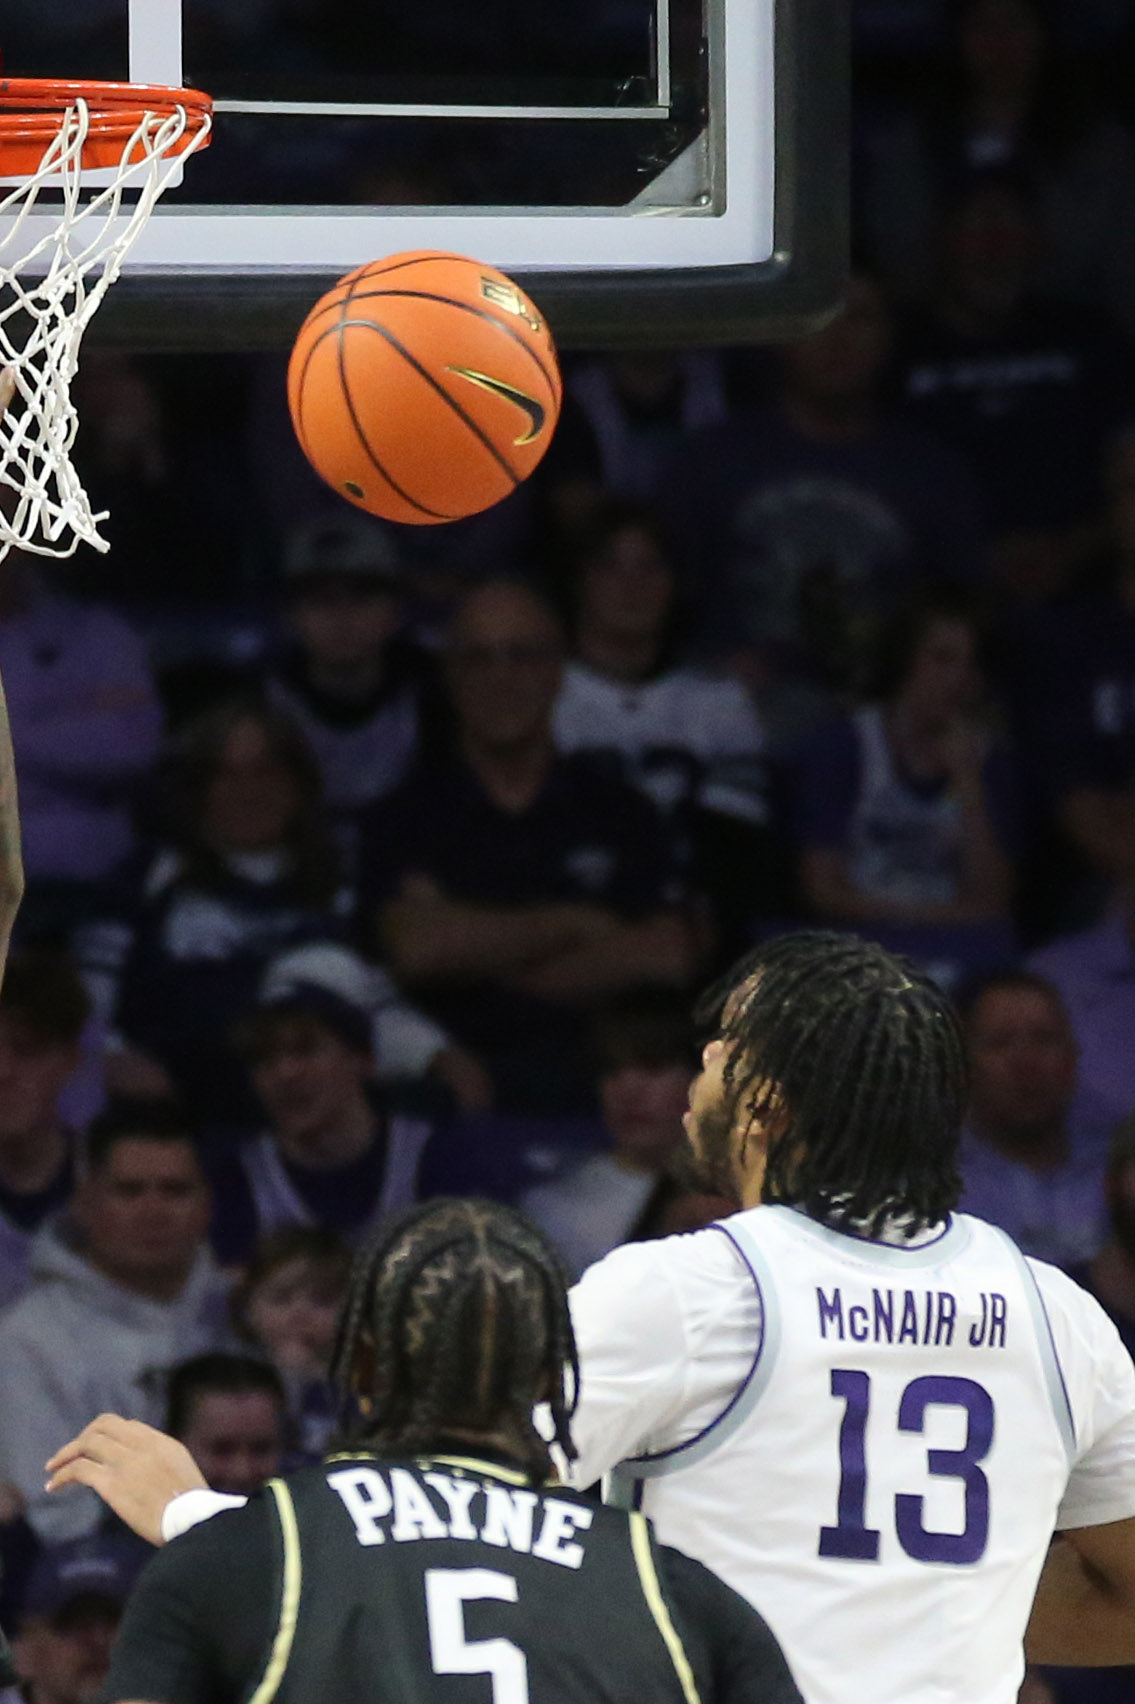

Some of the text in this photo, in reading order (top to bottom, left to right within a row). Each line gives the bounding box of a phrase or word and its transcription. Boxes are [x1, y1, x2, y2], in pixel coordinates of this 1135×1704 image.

[816, 1286, 1007, 1348] McNAIR JR
[327, 1466, 594, 1570] PAYNE
[818, 1368, 995, 1565] 13
